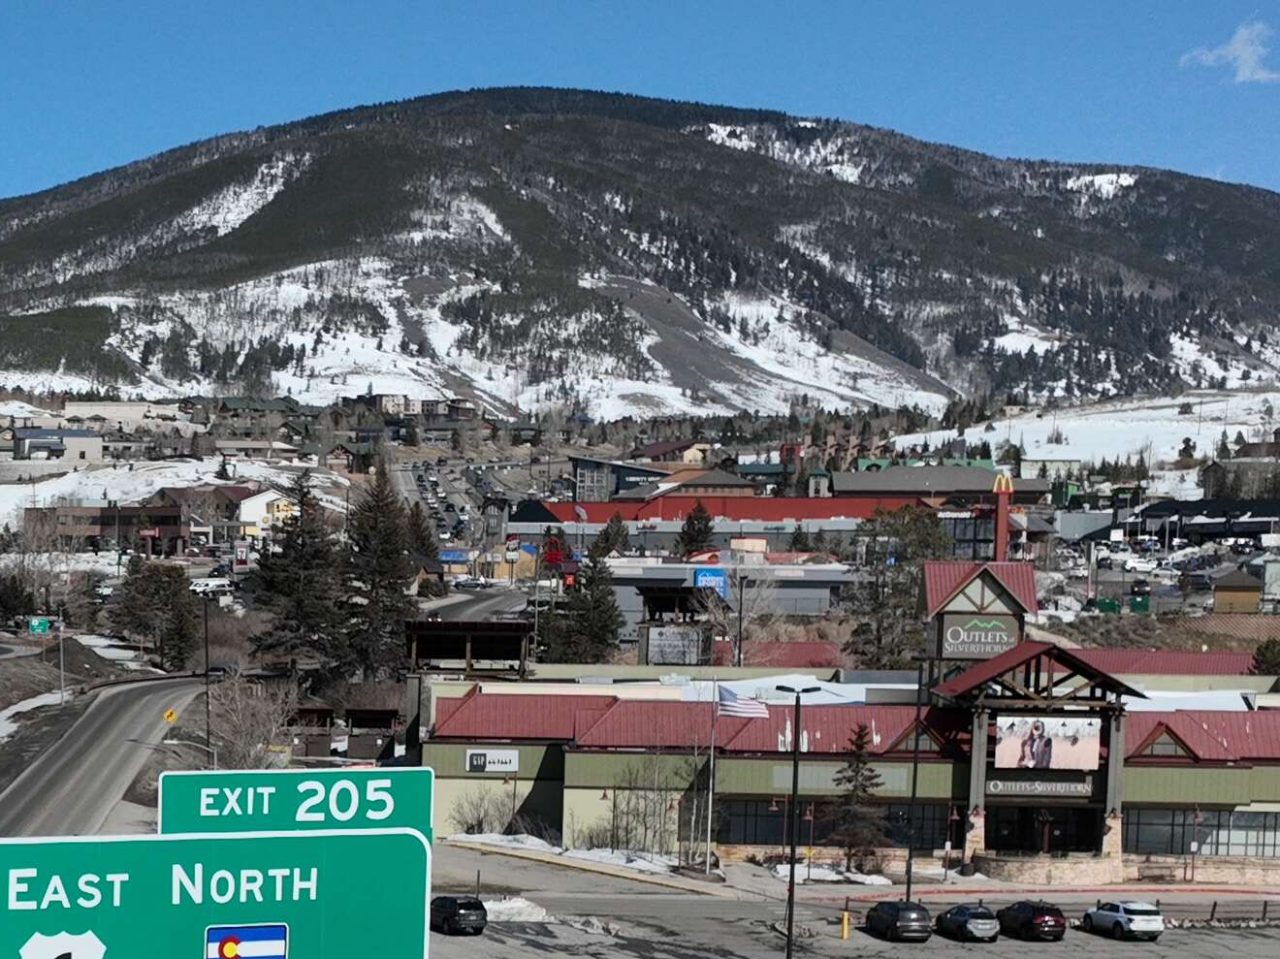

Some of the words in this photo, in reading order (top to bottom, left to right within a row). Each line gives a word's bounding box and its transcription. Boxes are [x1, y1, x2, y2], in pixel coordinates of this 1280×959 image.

[947, 626, 1008, 643] OUTLETS
[200, 787, 276, 816] EXIT
[295, 780, 395, 822] 205
[8, 868, 129, 910] EAST
[172, 863, 318, 905] NORTH
